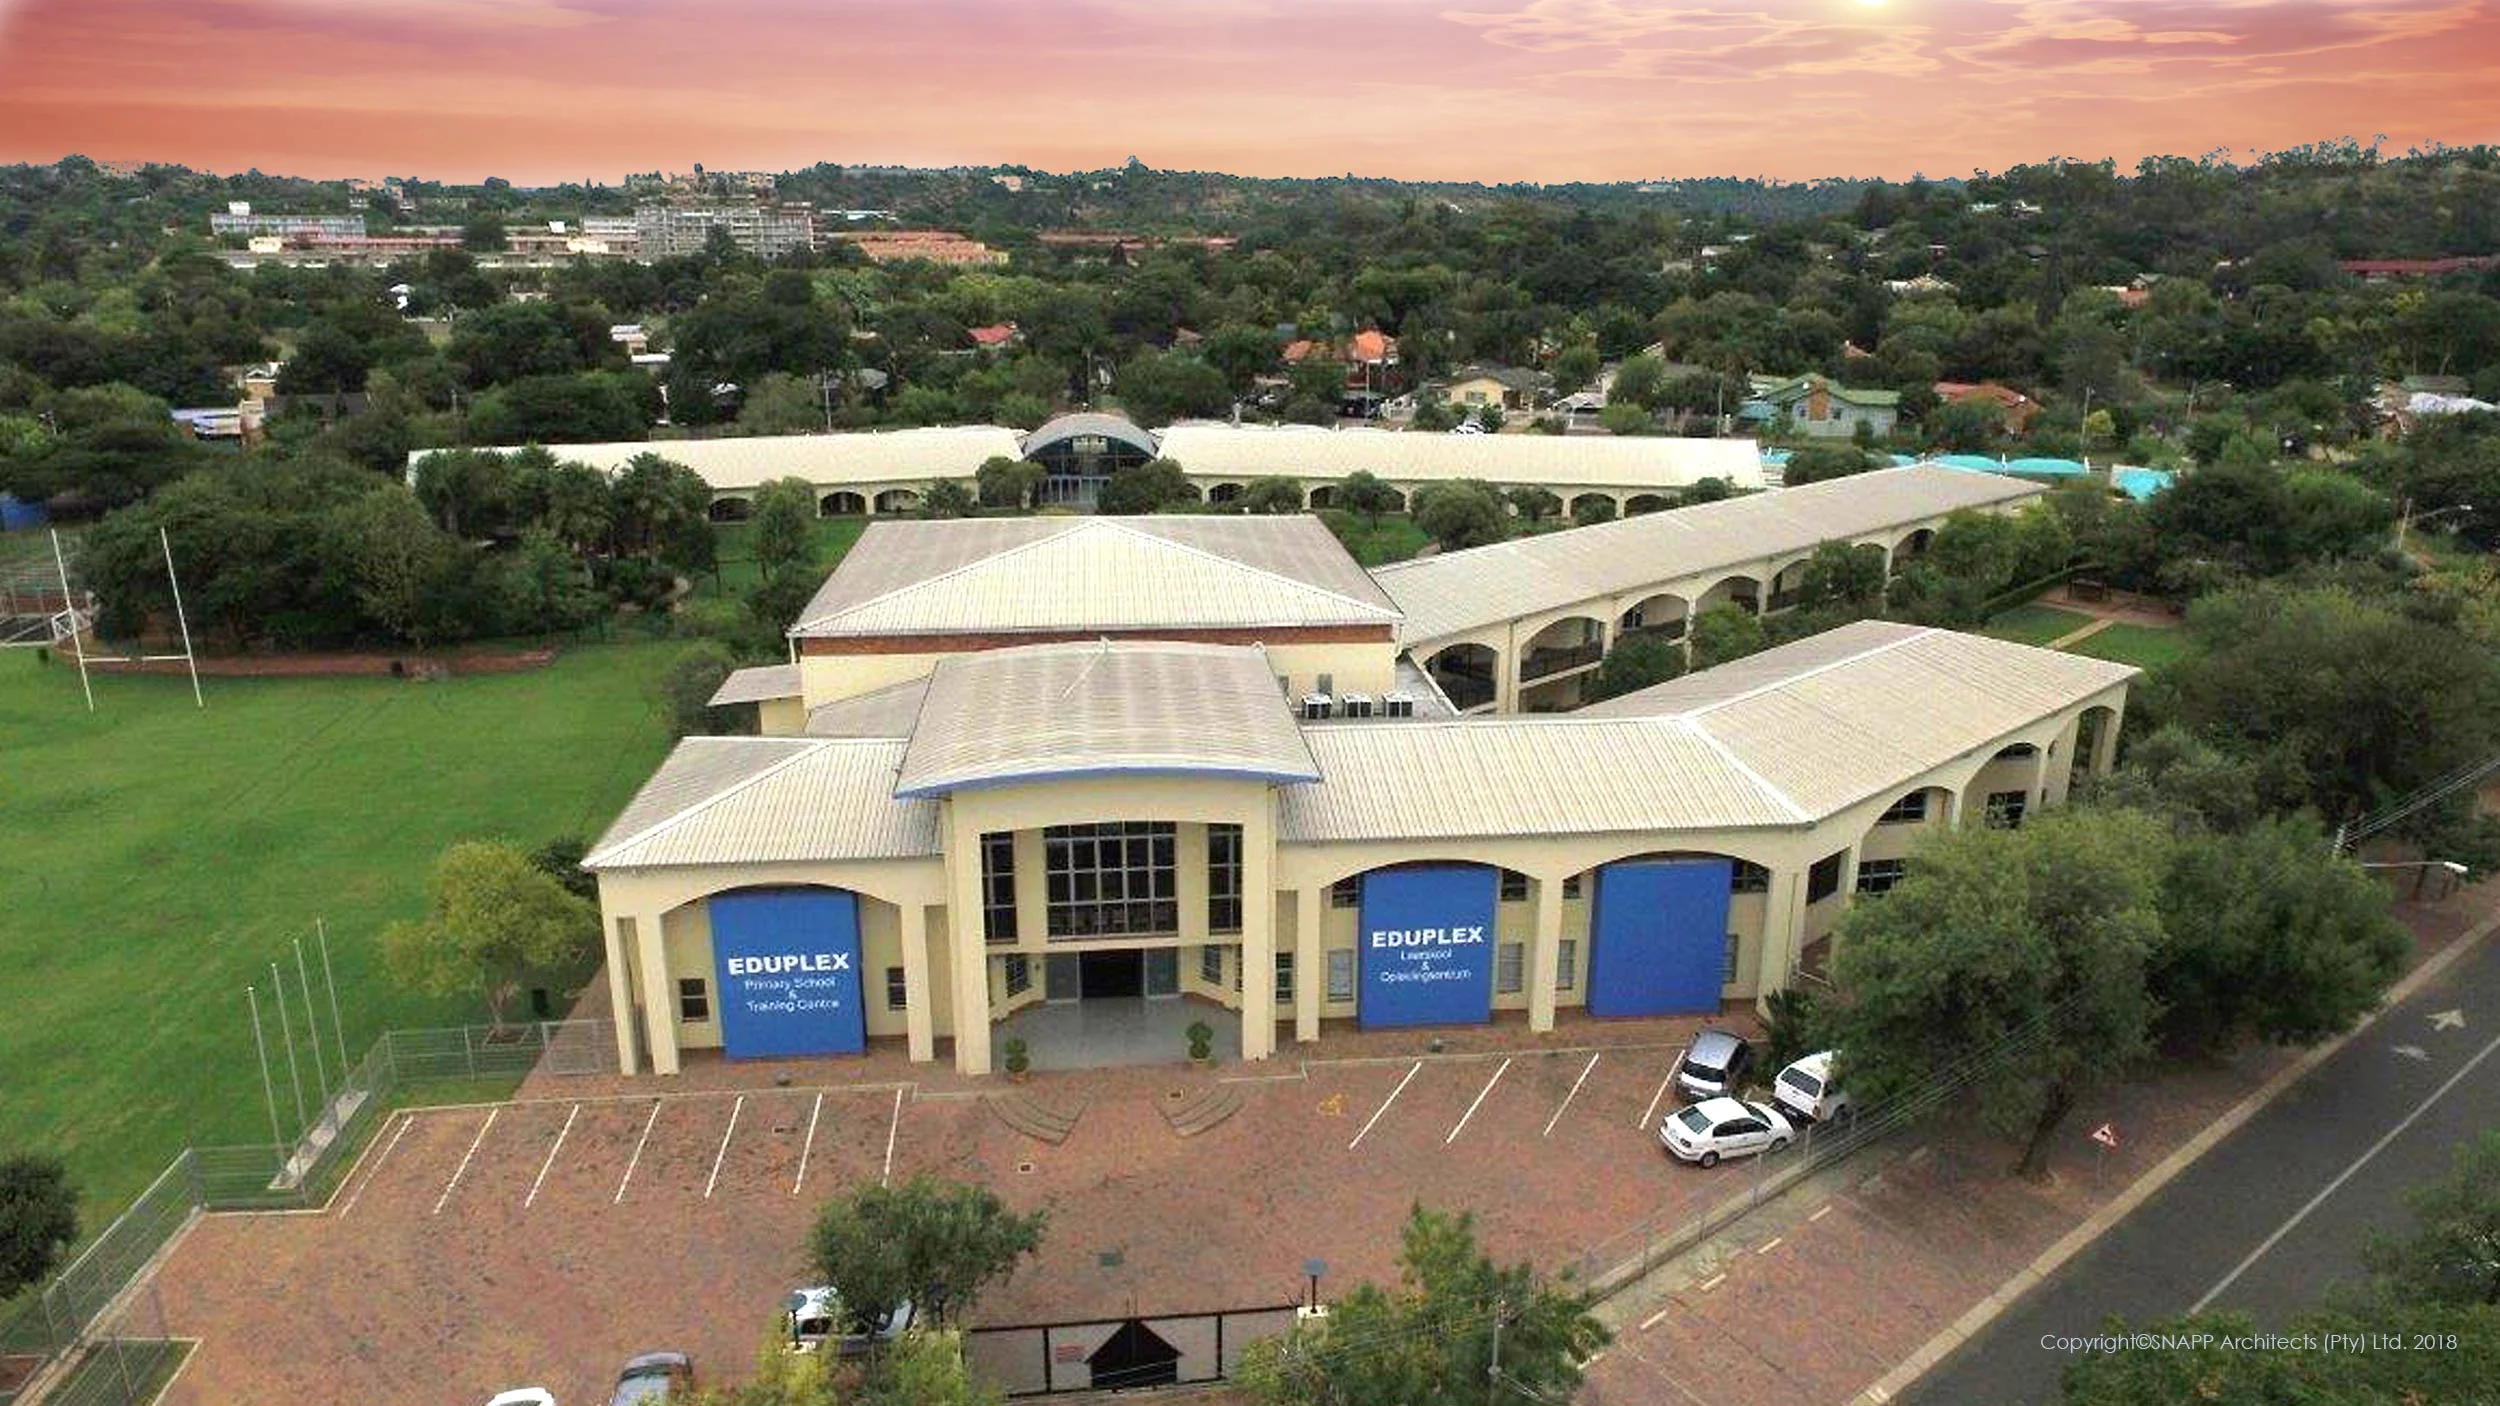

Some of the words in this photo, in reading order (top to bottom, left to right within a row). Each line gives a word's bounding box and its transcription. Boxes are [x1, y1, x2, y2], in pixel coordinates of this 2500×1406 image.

[1372, 926, 1484, 947] EDUPLEX
[727, 952, 849, 975] EDUPLEX
[745, 979, 790, 990] Primary
[794, 976, 836, 988] School
[746, 1001, 795, 1012] Training
[797, 999, 840, 1010] Centre
